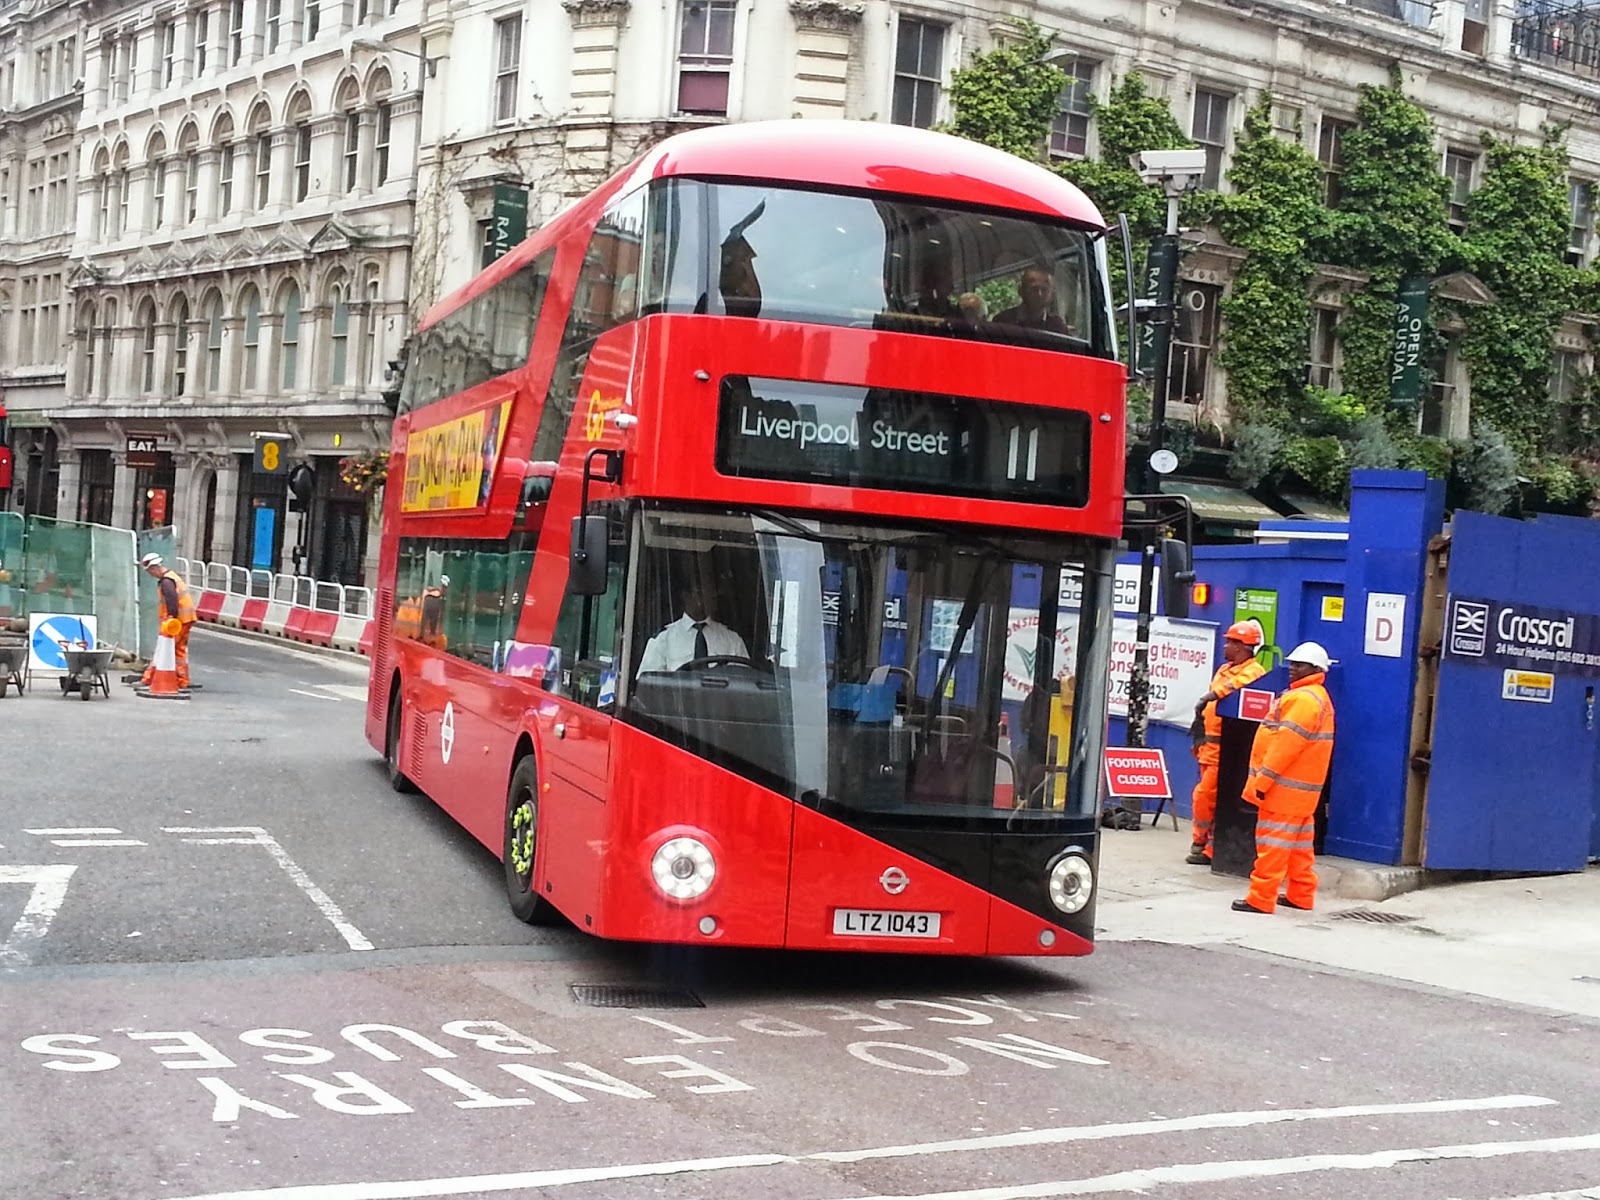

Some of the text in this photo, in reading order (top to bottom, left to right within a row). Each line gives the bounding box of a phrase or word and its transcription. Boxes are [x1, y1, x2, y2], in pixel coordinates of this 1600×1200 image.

[495, 216, 510, 258] RAIL
[1143, 267, 1161, 348] RAIAY
[1397, 303, 1410, 324] AS
[1391, 328, 1408, 385] USUAL
[1406, 318, 1422, 367] OPEN
[741, 406, 1039, 482] Liverpool Street 11
[1375, 601, 1398, 609] GATE
[1375, 617, 1393, 642] D
[1498, 608, 1574, 649] Crossrail
[1161, 642, 1178, 660] the
[1178, 644, 1207, 668] image
[1495, 643, 1507, 655] 24
[1507, 644, 1526, 657] Hour
[1525, 646, 1555, 661] Helpline
[1108, 758, 1161, 769] FOOTPATH
[1117, 774, 1158, 786] CLOSED
[846, 912, 929, 933] LTZ 1043
[20, 1019, 560, 1073] BUSES
[196, 1032, 1111, 1122] NO ENTRY
